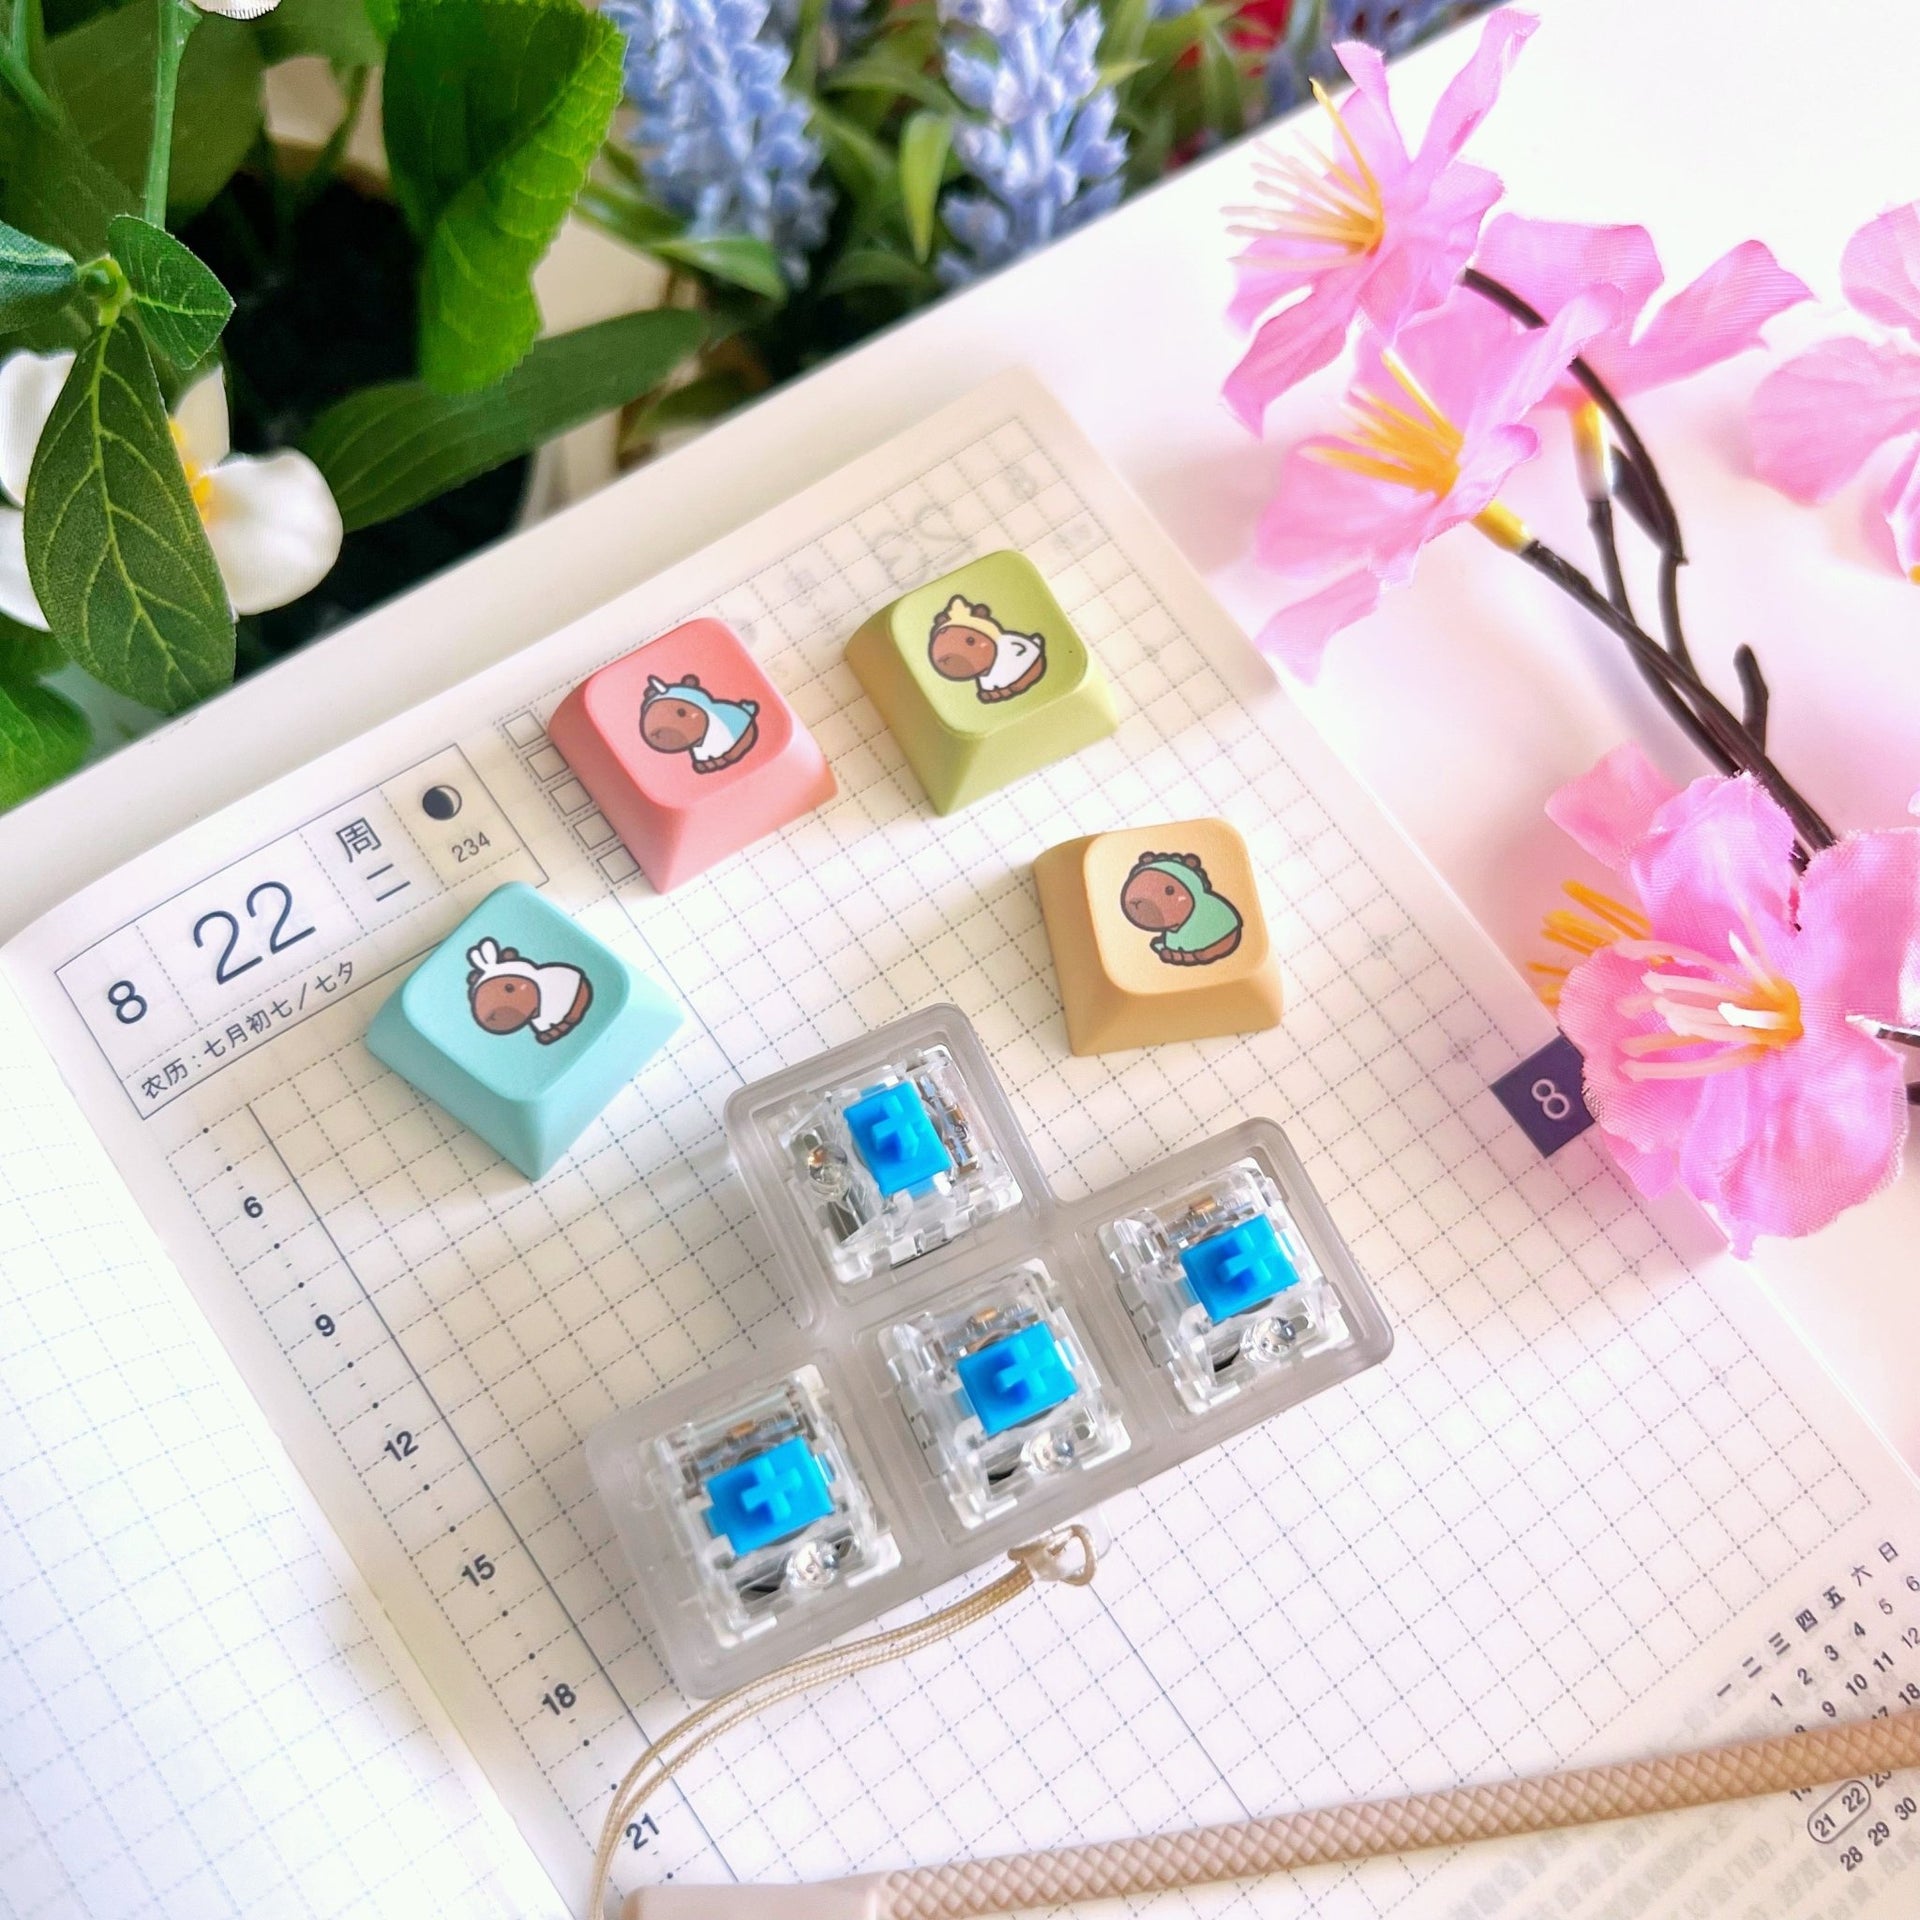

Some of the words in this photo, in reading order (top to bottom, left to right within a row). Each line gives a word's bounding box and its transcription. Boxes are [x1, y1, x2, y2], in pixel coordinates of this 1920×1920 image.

[335, 817, 411, 902] 周二
[451, 831, 492, 863] 234
[192, 880, 317, 985] 22
[107, 980, 148, 1025] 8
[1531, 1078, 1570, 1120] 8
[243, 1196, 264, 1218] 6
[315, 1314, 336, 1337] 9
[384, 1431, 420, 1462] 12
[461, 1554, 496, 1587] 15
[1768, 1632, 1791, 1656] 三
[1795, 1608, 1818, 1633] 四
[1822, 1585, 1846, 1610] 五
[1850, 1565, 1873, 1588] 六
[1878, 1541, 1899, 1563] 日
[1770, 1692, 1783, 1707] 1
[1797, 1667, 1813, 1685] 2
[1824, 1644, 1839, 1661] 3
[1853, 1621, 1866, 1636] 4
[1878, 1598, 1893, 1615] 5
[1905, 1575, 1920, 1592] 6
[1822, 1701, 1836, 1718] 9
[1845, 1673, 1868, 1696] 10
[1873, 1651, 1894, 1673] 11
[1901, 1627, 1920, 1649] 12
[542, 1682, 577, 1716] 18
[1898, 1683, 1920, 1706] 18
[625, 1813, 661, 1850] 21
[1815, 1813, 1836, 1838] 21
[1842, 1787, 1866, 1813] 22
[1840, 1846, 1863, 1872] 28
[1867, 1821, 1890, 1847] 29
[1894, 1796, 1917, 1821] 30
